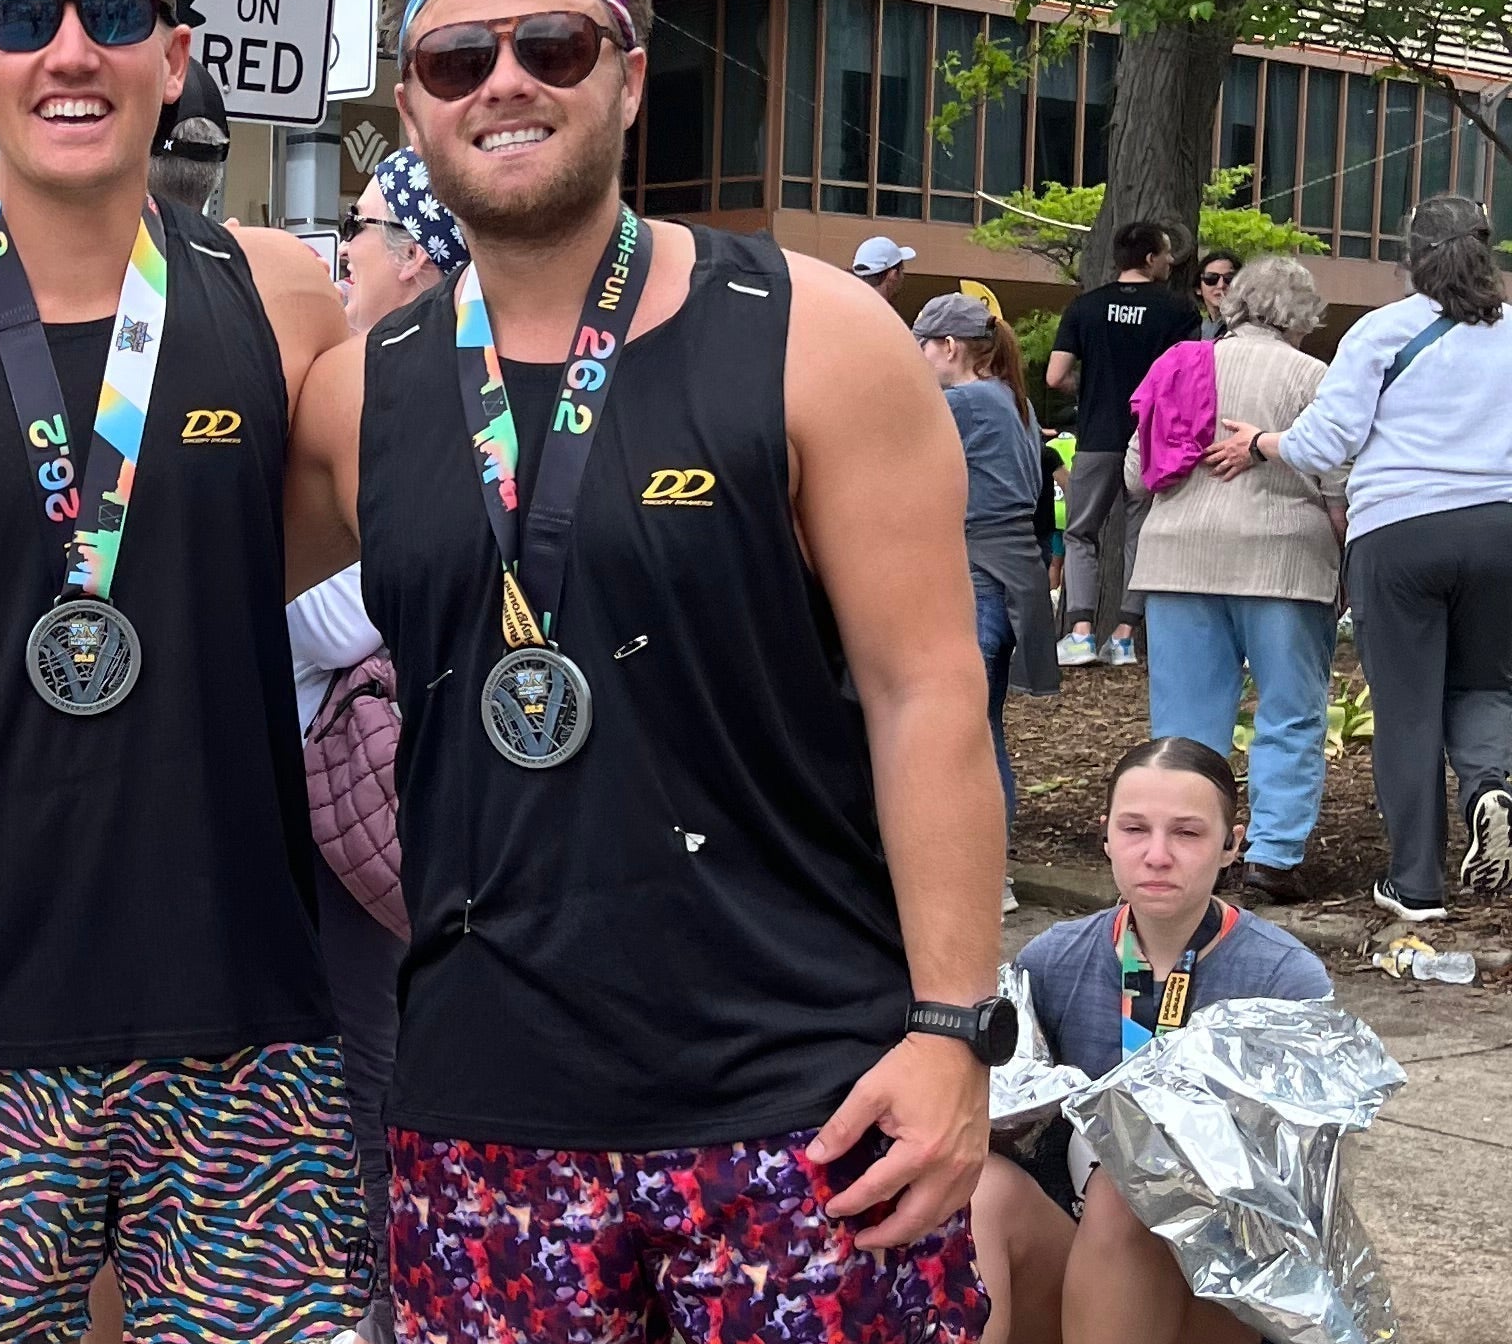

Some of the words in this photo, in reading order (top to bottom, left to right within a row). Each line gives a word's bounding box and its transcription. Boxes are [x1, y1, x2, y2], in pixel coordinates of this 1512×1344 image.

[203, 33, 304, 95] RED
[1107, 304, 1147, 325] FIGHT
[553, 325, 616, 435] 26.2
[181, 409, 242, 438] DD
[28, 413, 81, 523] 26.2
[641, 469, 716, 499] DD
